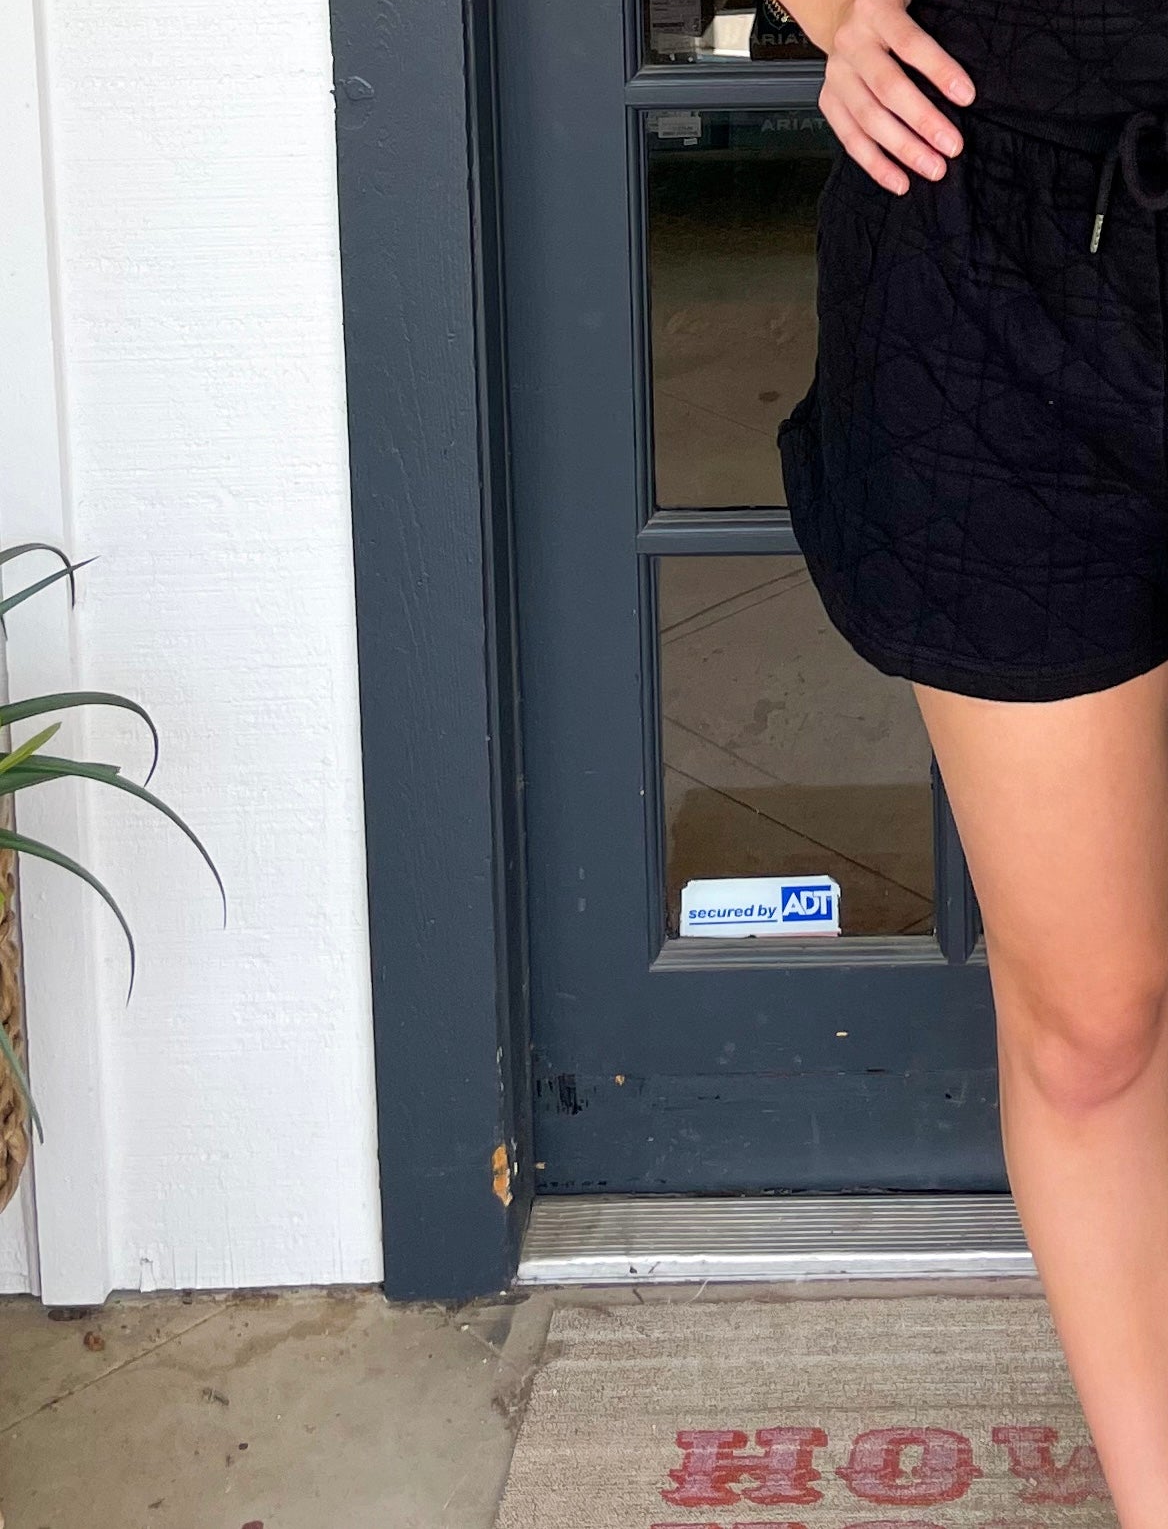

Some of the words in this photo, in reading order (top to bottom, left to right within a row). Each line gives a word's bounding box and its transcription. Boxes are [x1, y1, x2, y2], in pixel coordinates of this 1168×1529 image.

[761, 117, 826, 132] ARIAT
[688, 904, 755, 919] secured
[757, 903, 778, 919] by
[782, 889, 833, 917] ADT
